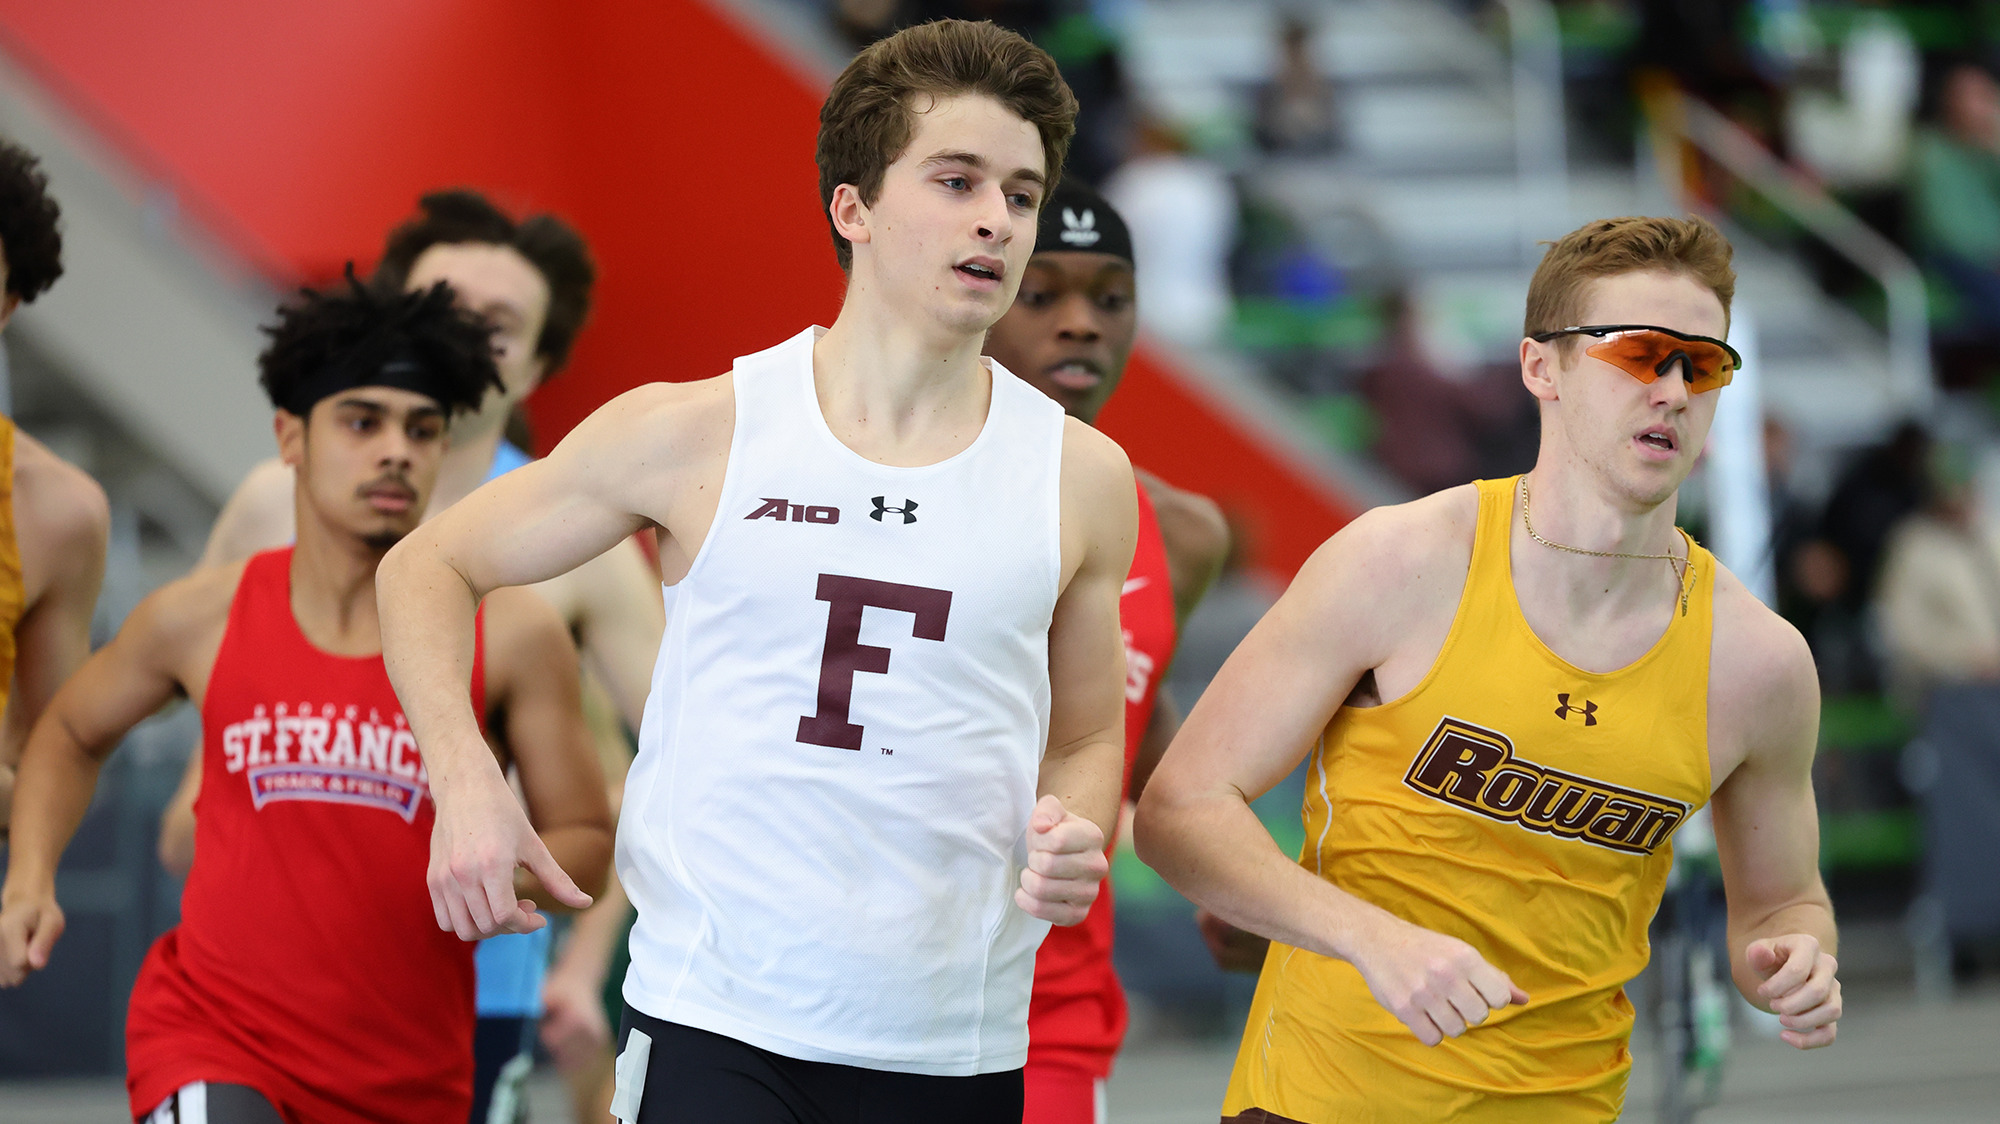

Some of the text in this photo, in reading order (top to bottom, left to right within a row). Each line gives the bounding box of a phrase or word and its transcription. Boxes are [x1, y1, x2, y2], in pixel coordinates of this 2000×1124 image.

[743, 498, 840, 525] A10
[796, 573, 953, 751] F
[253, 701, 406, 727] BROOKLY
[880, 747, 894, 756] TM
[1403, 716, 1691, 856] Rowan
